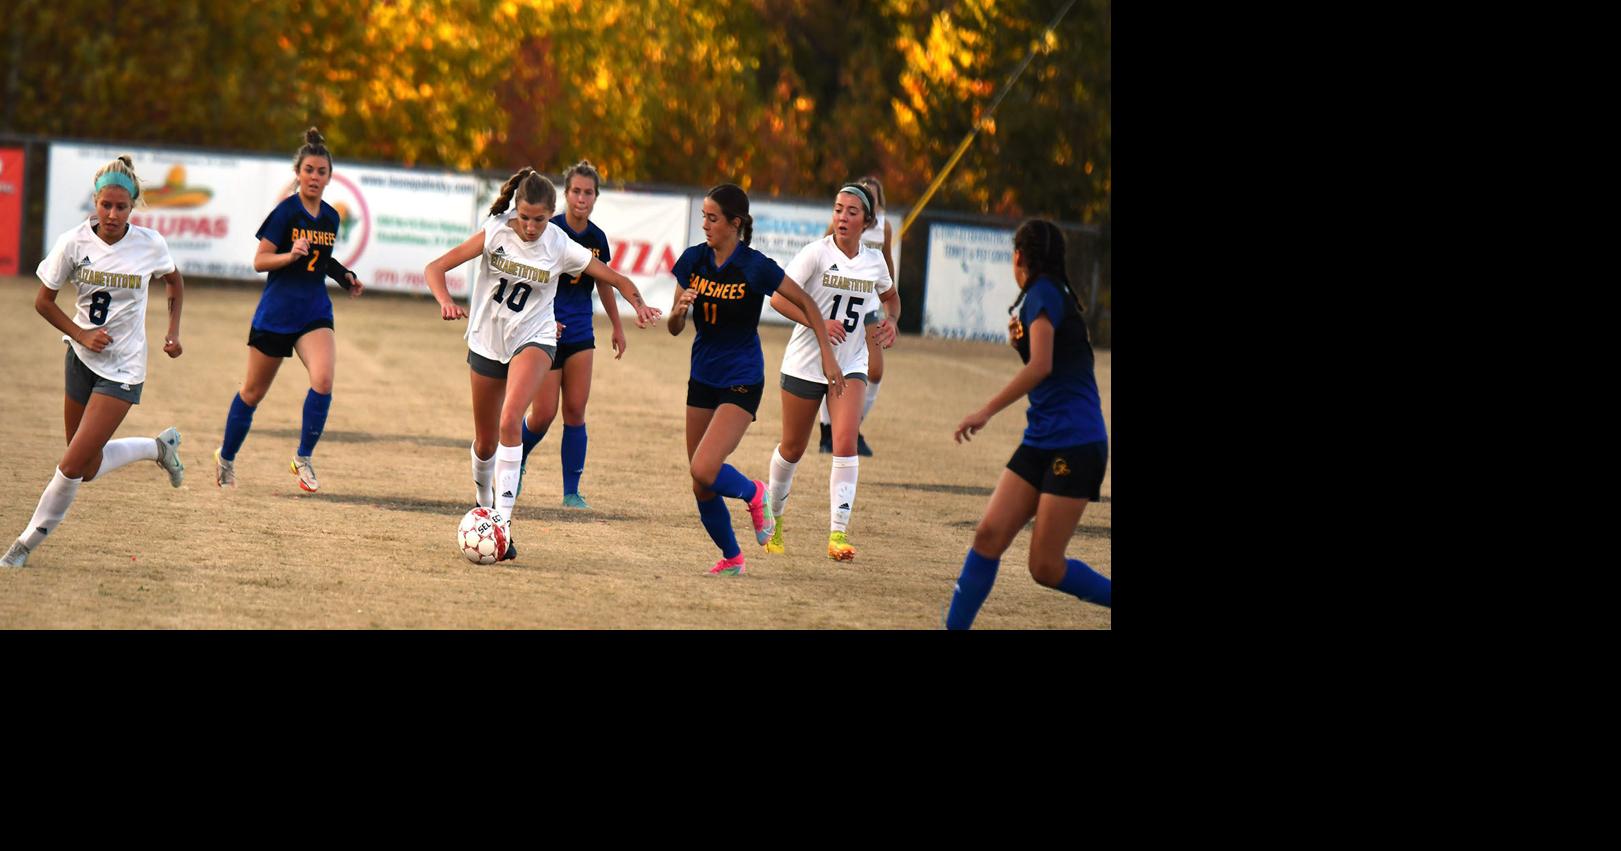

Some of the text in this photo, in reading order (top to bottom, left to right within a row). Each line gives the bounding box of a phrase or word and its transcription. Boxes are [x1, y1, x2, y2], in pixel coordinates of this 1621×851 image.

[307, 250, 320, 271] 2
[89, 291, 112, 326] 8
[493, 277, 532, 313] 10
[703, 302, 717, 325] 11
[829, 294, 864, 334] 15
